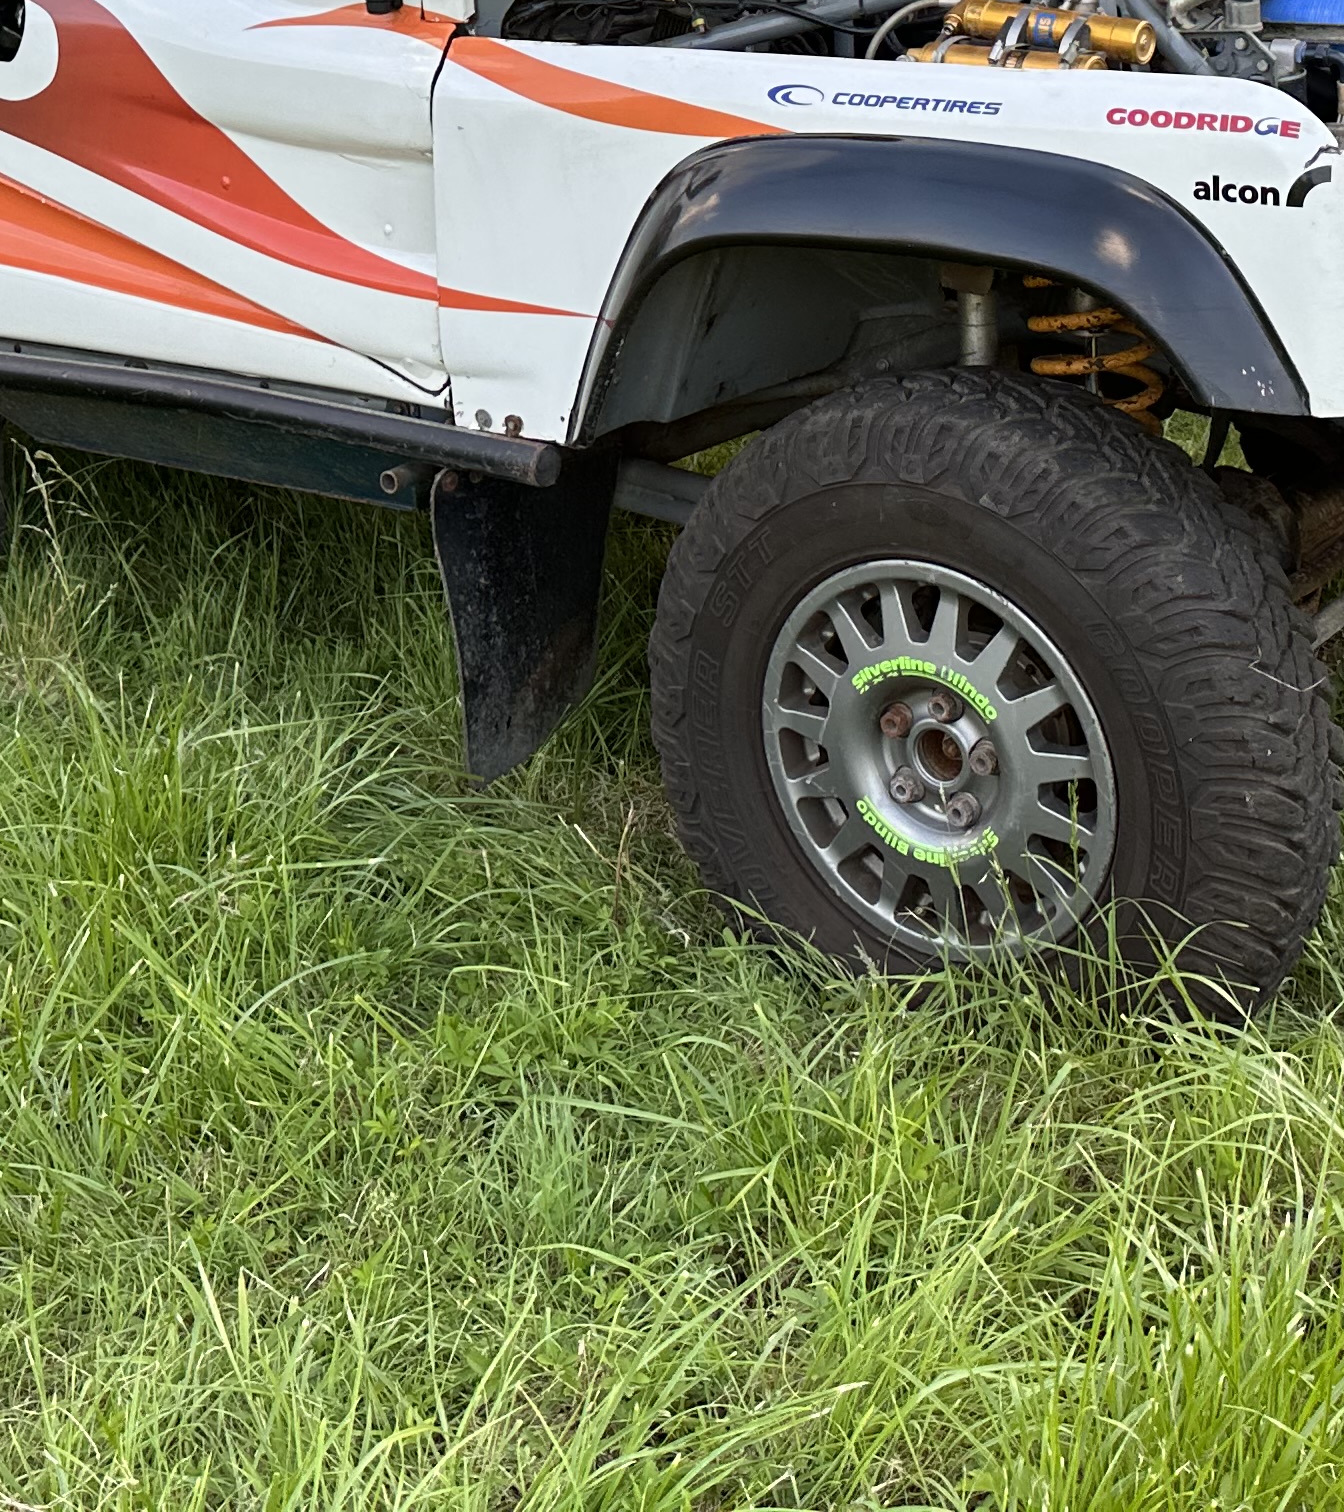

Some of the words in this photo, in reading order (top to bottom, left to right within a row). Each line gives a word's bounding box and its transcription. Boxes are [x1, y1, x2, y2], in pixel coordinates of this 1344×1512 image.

[831, 91, 1003, 116] COOPERTIRES
[1106, 107, 1302, 139] GOODRIDGE
[1193, 175, 1280, 206] alcon
[709, 526, 776, 630] STT
[851, 655, 937, 689] Silverline
[856, 799, 911, 857] Blindo
